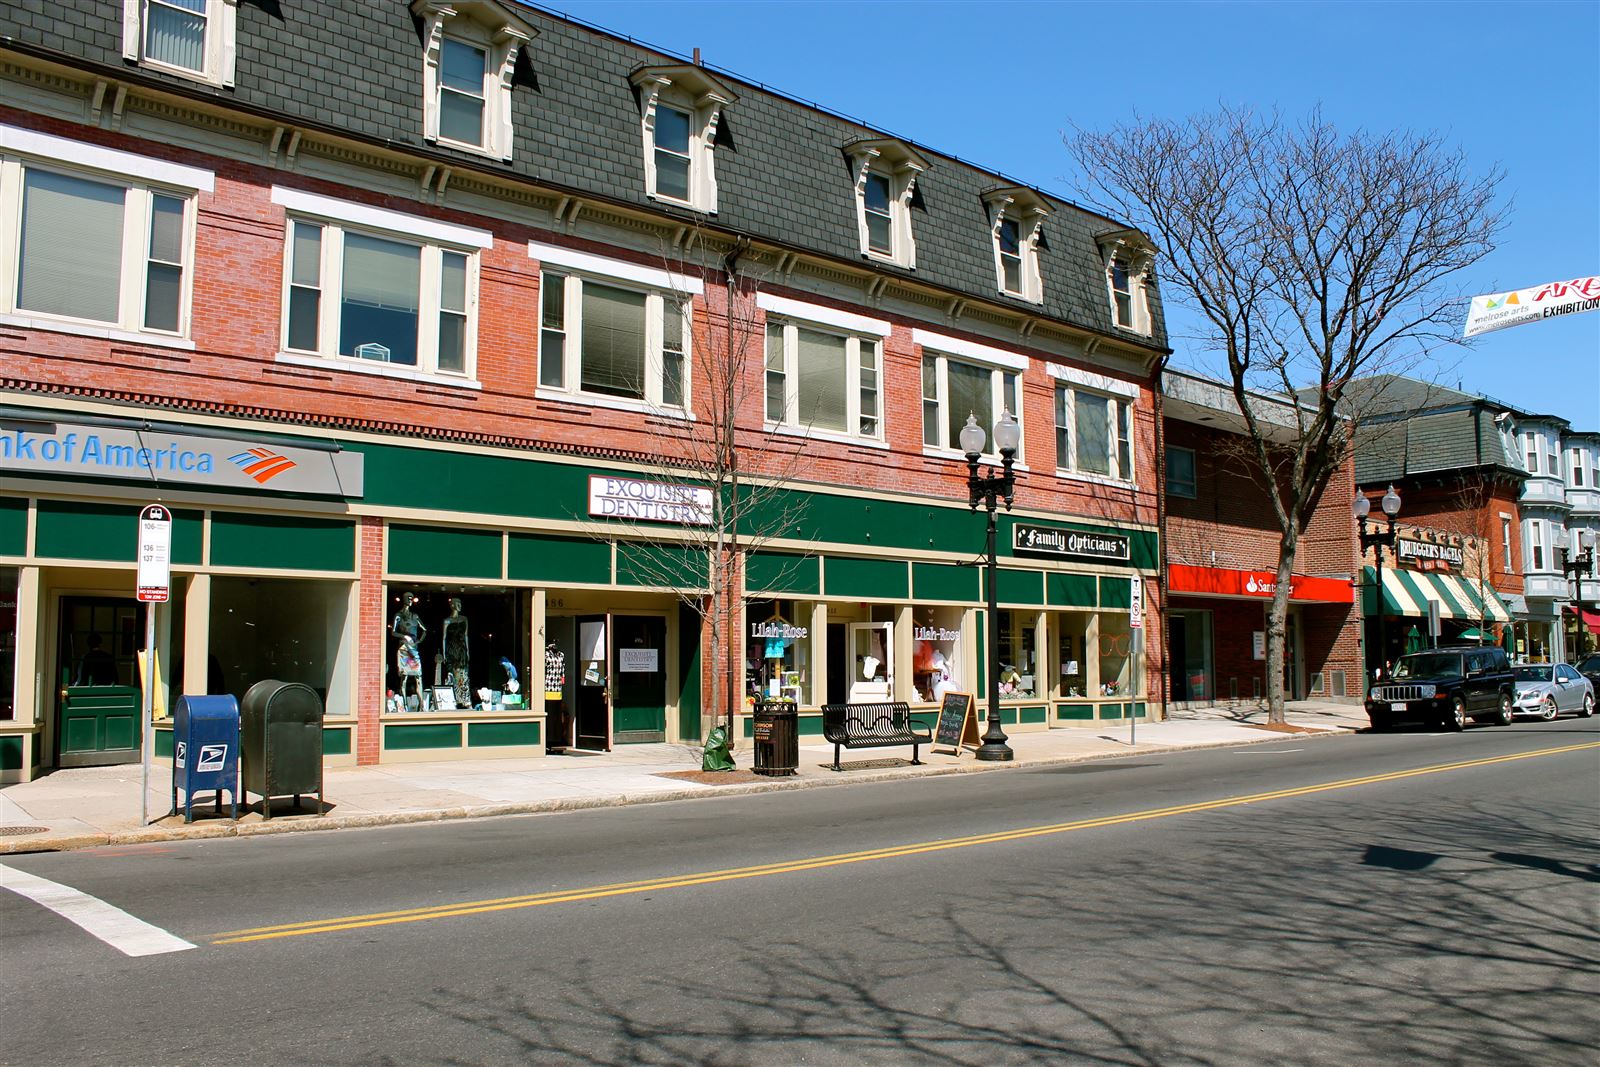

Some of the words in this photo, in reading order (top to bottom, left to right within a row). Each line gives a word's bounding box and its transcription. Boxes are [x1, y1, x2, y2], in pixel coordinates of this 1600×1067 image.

[1511, 305, 1529, 315] arts
[1543, 298, 1600, 318] EXHIBITION
[41, 433, 77, 463] of
[81, 435, 214, 473] America
[606, 479, 699, 502] EXQUISITE
[601, 498, 701, 523] DENTISTRY
[1026, 529, 1065, 550] Family
[1068, 534, 1117, 552] Opticians
[752, 622, 808, 638] Lilah-Rose
